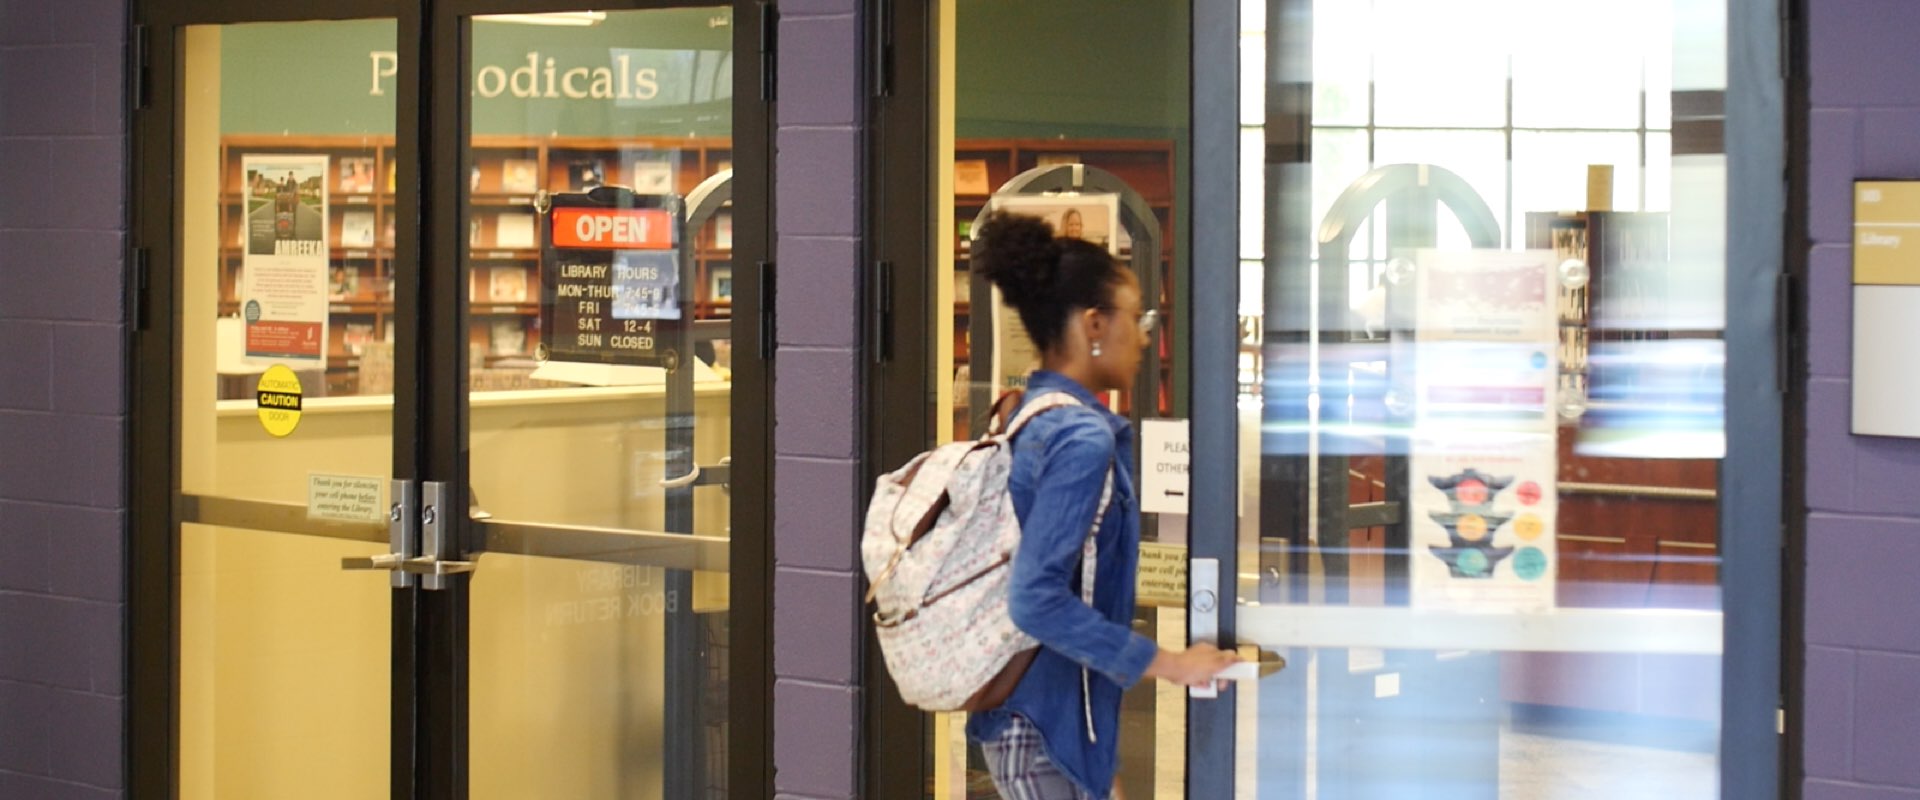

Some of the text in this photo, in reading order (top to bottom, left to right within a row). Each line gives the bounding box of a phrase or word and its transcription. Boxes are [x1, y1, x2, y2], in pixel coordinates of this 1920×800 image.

[369, 51, 659, 99] Podicals
[575, 214, 647, 243] OPEN
[275, 240, 324, 256] AMREEKA
[561, 265, 658, 281] LIBRARY HOURS
[579, 301, 600, 315] FRI
[578, 318, 651, 333] SAT 12-4
[578, 335, 654, 350] SUN CLOSED
[260, 379, 300, 391] AUTOMATIC
[261, 393, 299, 408] CAUTION
[269, 411, 289, 421] DOOR
[1164, 441, 1189, 454] PLEA
[313, 477, 330, 487] Thank
